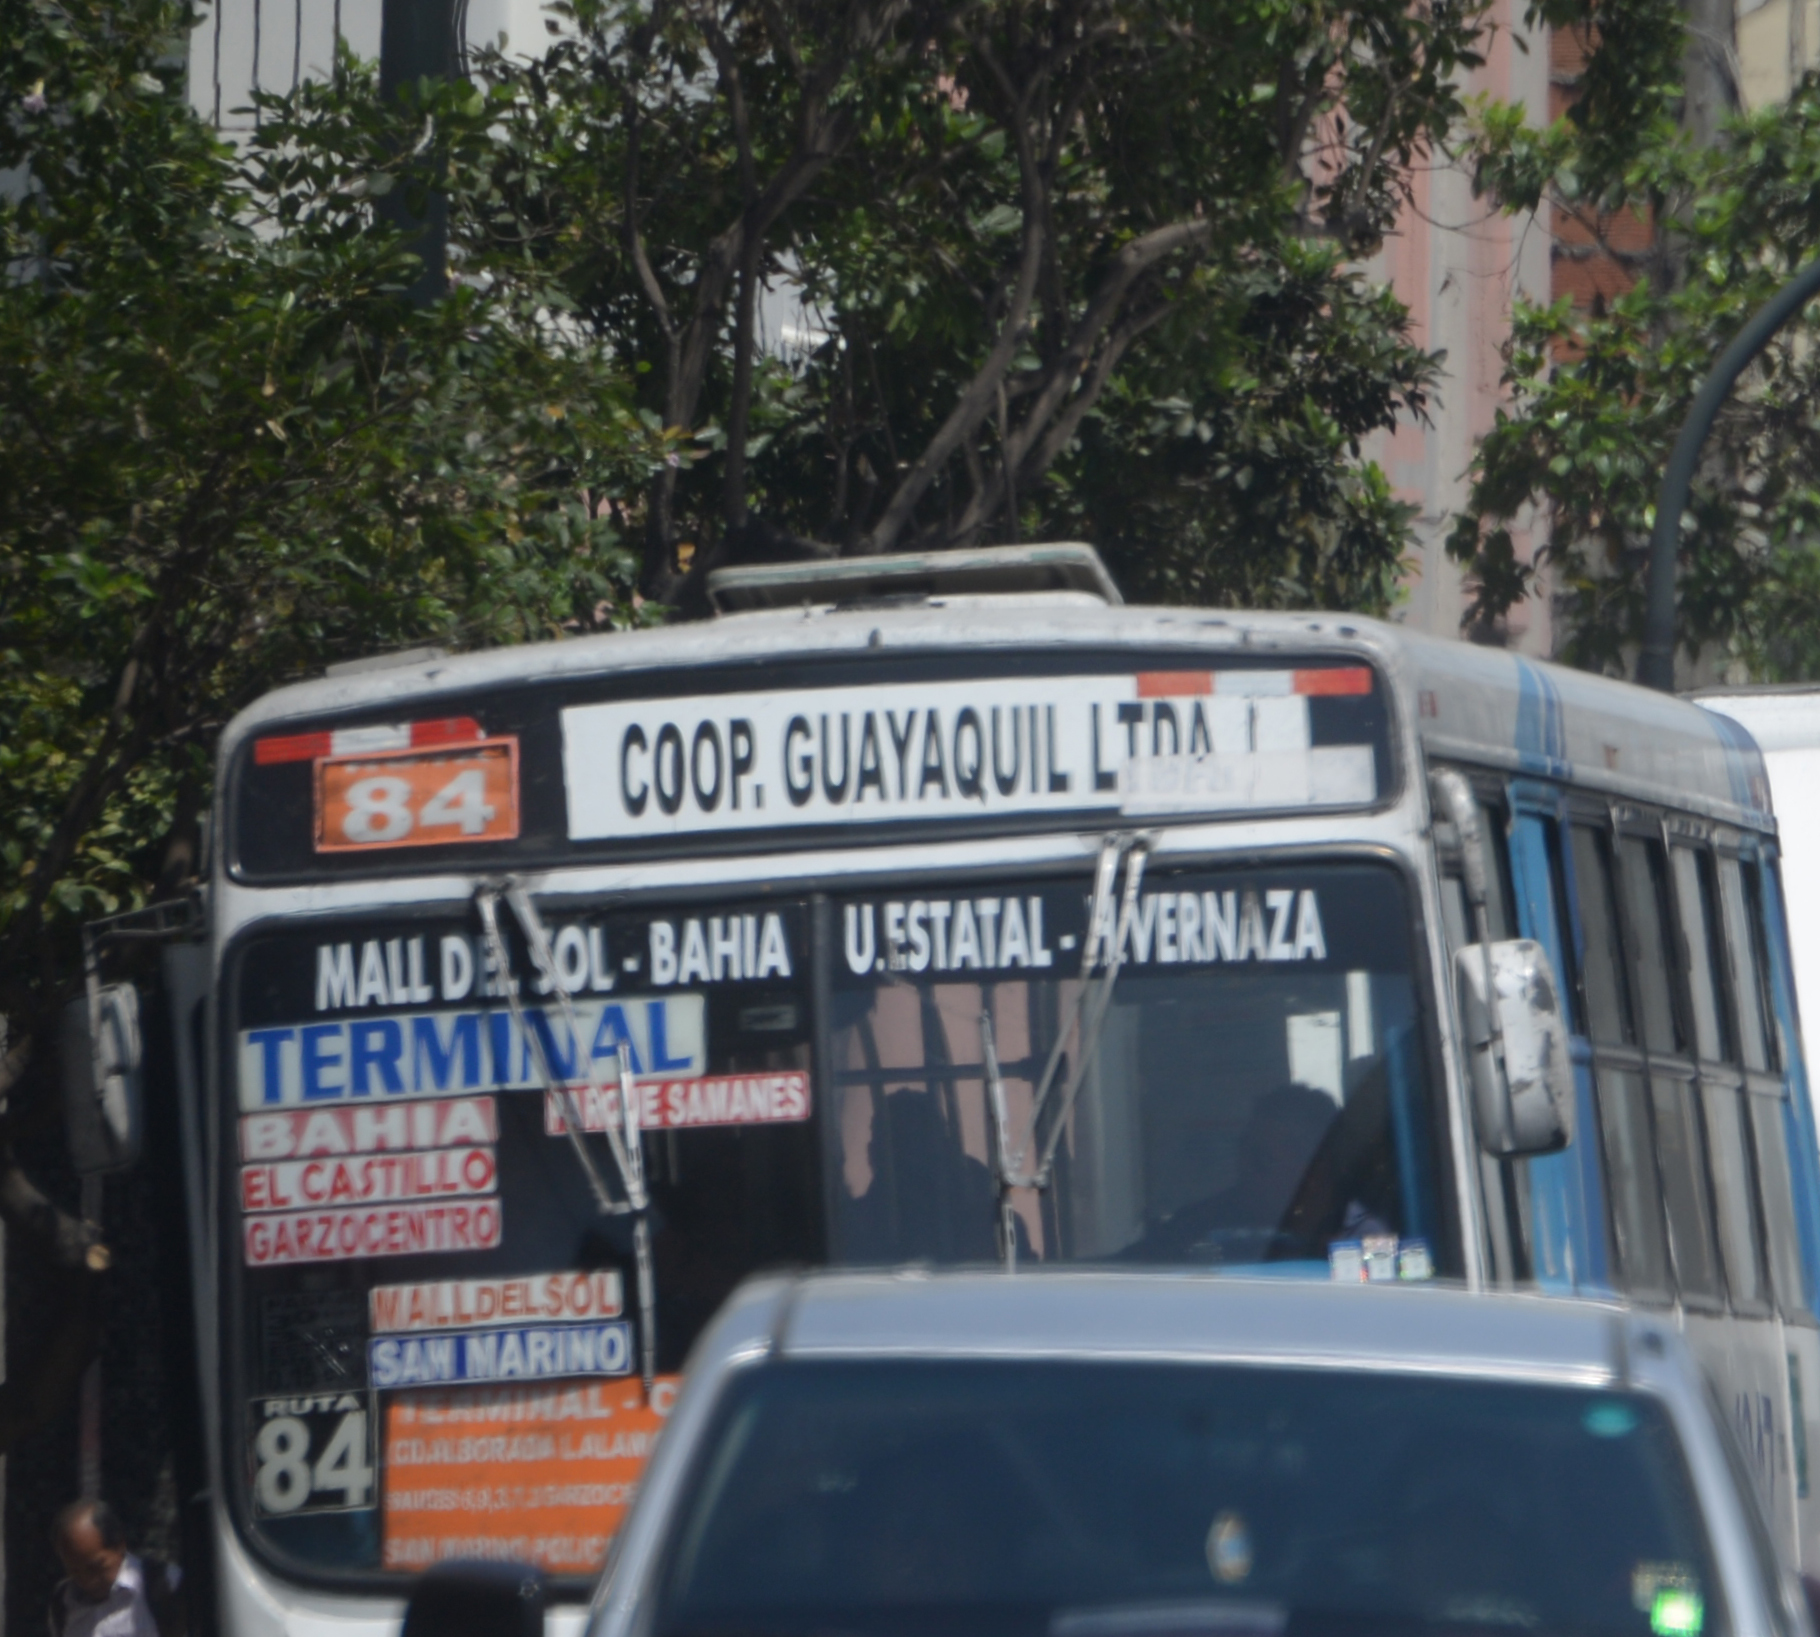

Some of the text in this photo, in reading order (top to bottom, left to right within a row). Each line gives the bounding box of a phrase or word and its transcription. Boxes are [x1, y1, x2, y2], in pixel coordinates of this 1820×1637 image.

[619, 718, 765, 818] COOP.
[783, 702, 1070, 808] GUAYAQUIL
[342, 768, 497, 843] 84
[314, 938, 433, 1012] MALL
[649, 913, 791, 986] BAHIA
[246, 1000, 694, 1105] TERMINAL
[246, 1100, 490, 1160] BAHIA
[667, 1076, 806, 1126] SAMANES
[242, 1148, 497, 1210] EL CASTILLO
[246, 1205, 500, 1262] GARZOCENTRO
[373, 1338, 456, 1386] SAN
[464, 1326, 629, 1378] MARINO
[263, 1395, 361, 1416] RUTA
[255, 1410, 374, 1514] 84
